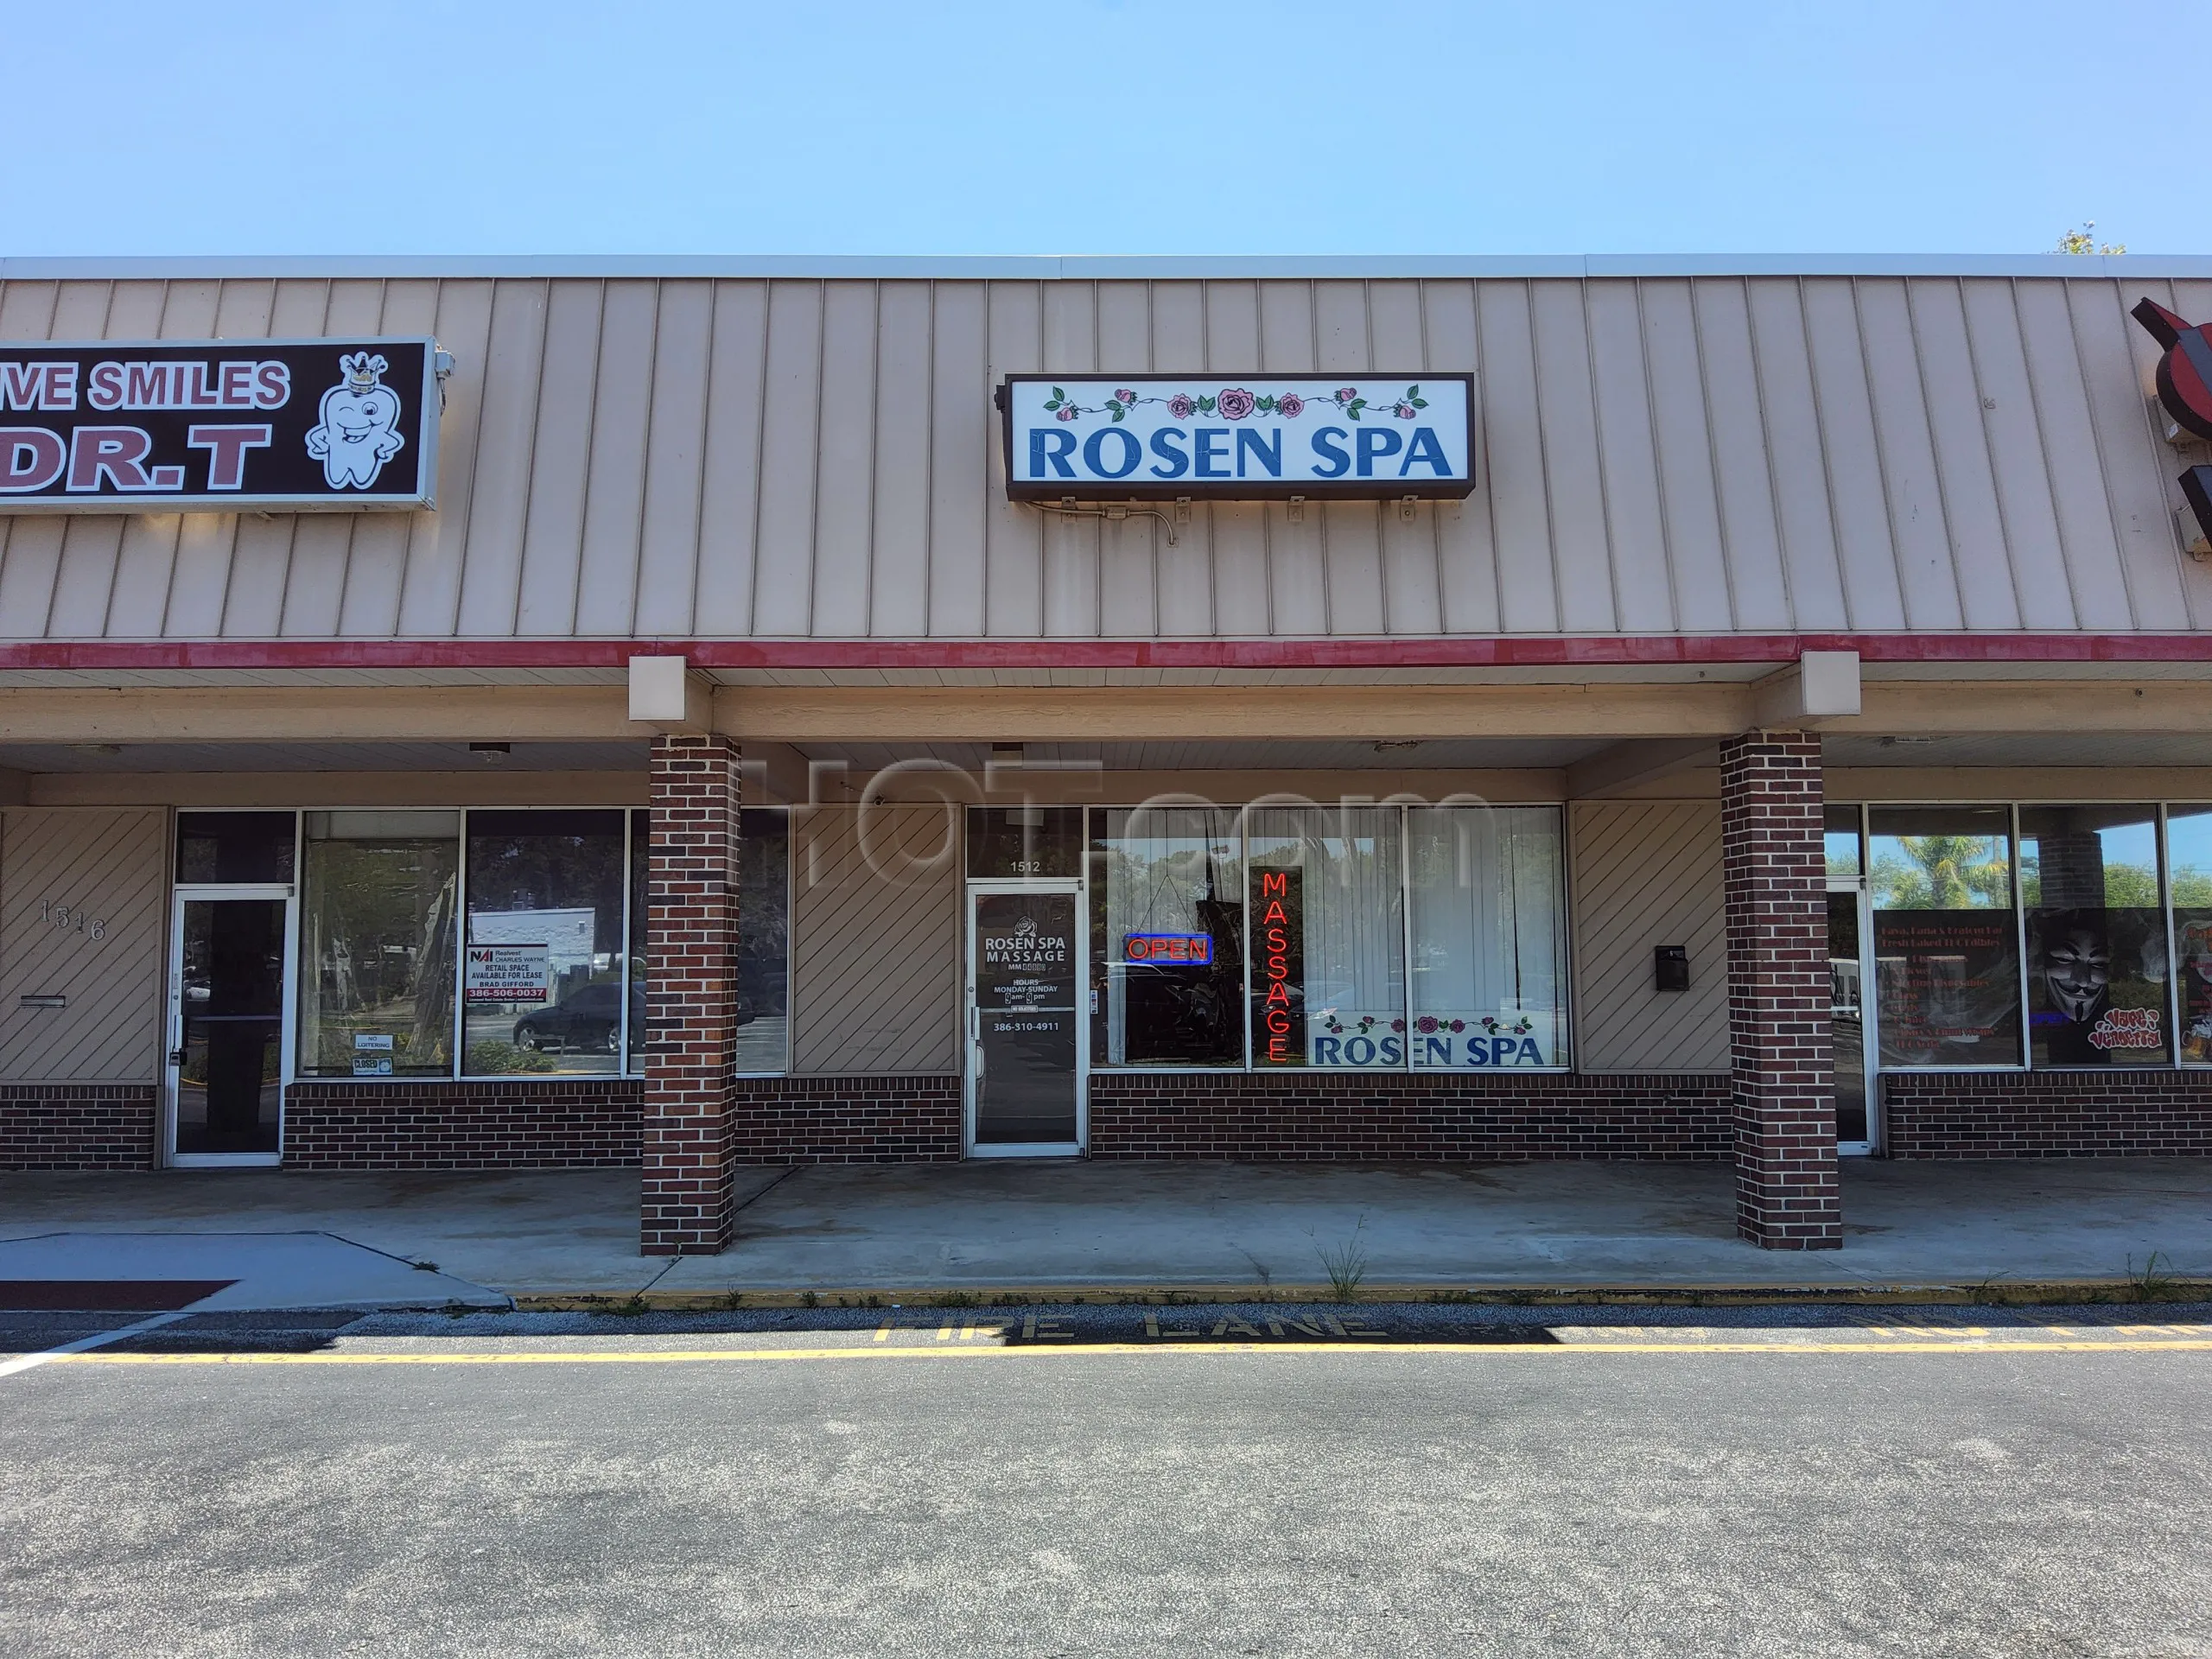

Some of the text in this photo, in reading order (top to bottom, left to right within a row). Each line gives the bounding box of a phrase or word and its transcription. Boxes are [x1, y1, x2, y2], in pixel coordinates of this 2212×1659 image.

[0, 360, 291, 411] VE SMILES
[1029, 426, 1453, 479] ROSEN SPA
[1010, 861, 1040, 872] 1512
[41, 899, 106, 941] 1516
[985, 938, 1065, 950] ROSEN SPA
[1128, 938, 1206, 960] OPEN
[470, 949, 493, 963] NAI
[986, 951, 1065, 963] MASSAGE
[1263, 873, 1291, 1063] MASSAGE
[994, 1022, 1058, 1031] 386-310-4911
[1315, 1037, 1544, 1065] ROSEN SPA
[354, 1059, 378, 1069] CLOSED
[873, 1313, 1389, 1342] FIRE LANE
